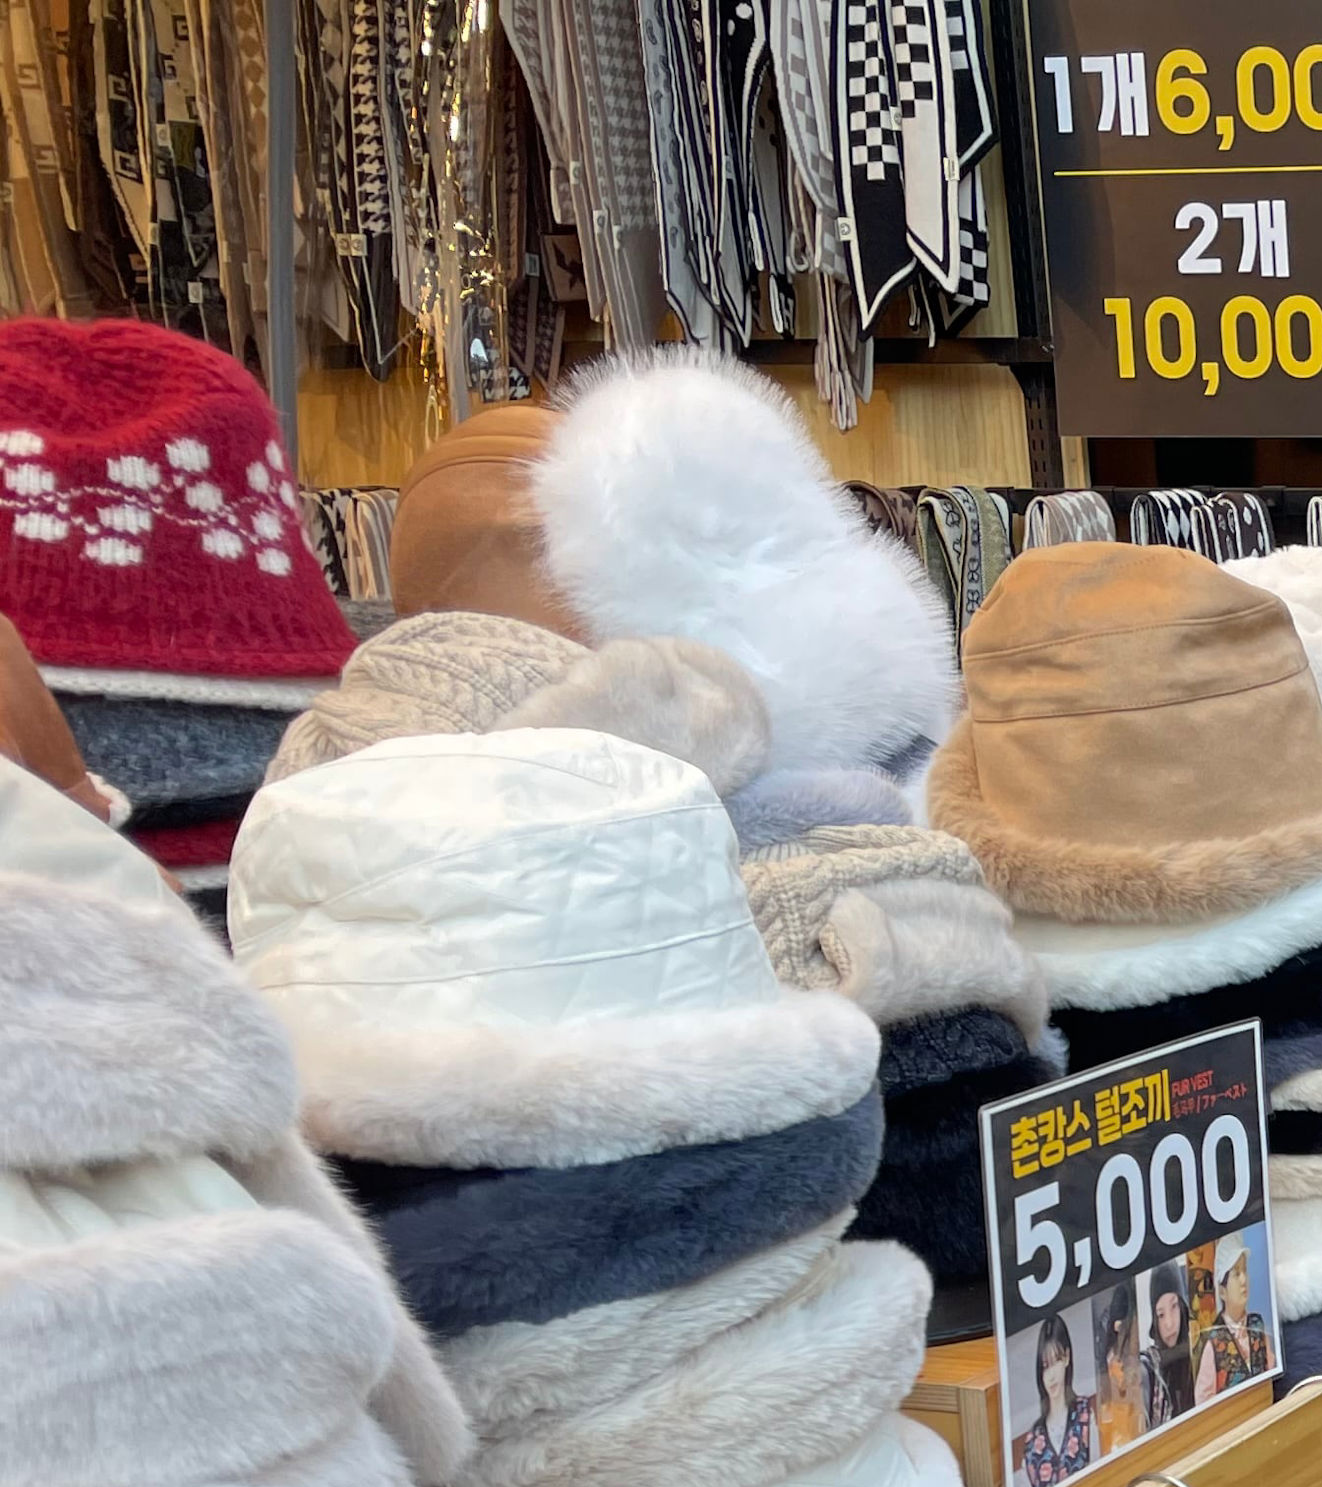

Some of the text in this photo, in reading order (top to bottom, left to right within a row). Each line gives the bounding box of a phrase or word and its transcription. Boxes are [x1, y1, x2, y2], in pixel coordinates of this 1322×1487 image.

[1174, 200, 1291, 279] 2개
[1010, 1068, 1171, 1180] 촌캉스 털조끼
[1014, 1114, 1251, 1309] 5,000
